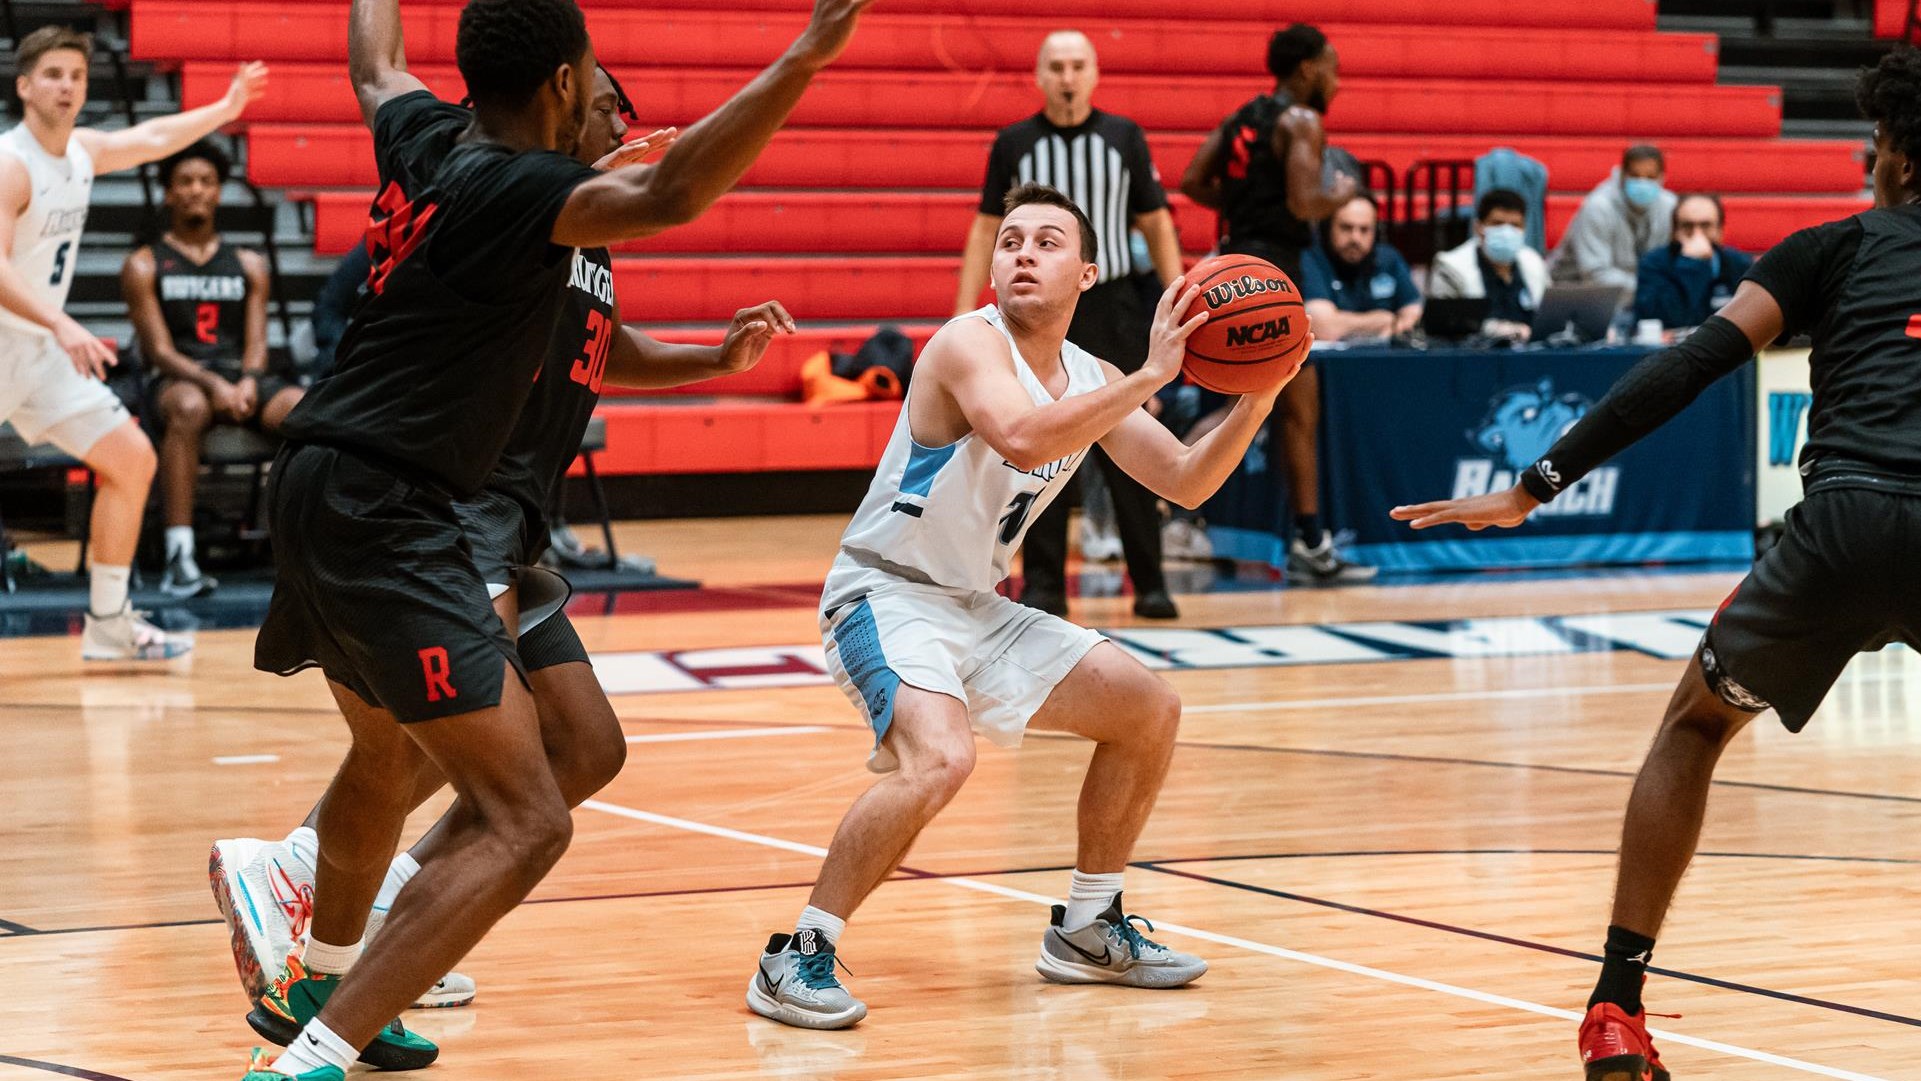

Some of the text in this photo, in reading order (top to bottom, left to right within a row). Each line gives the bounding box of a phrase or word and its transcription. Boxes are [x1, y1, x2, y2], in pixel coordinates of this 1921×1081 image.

[49, 240, 72, 286] 5
[1202, 275, 1293, 310] Wilson
[196, 302, 220, 344] 2
[1226, 315, 1291, 347] NCAA
[570, 308, 612, 394] 30
[418, 646, 458, 702] R
